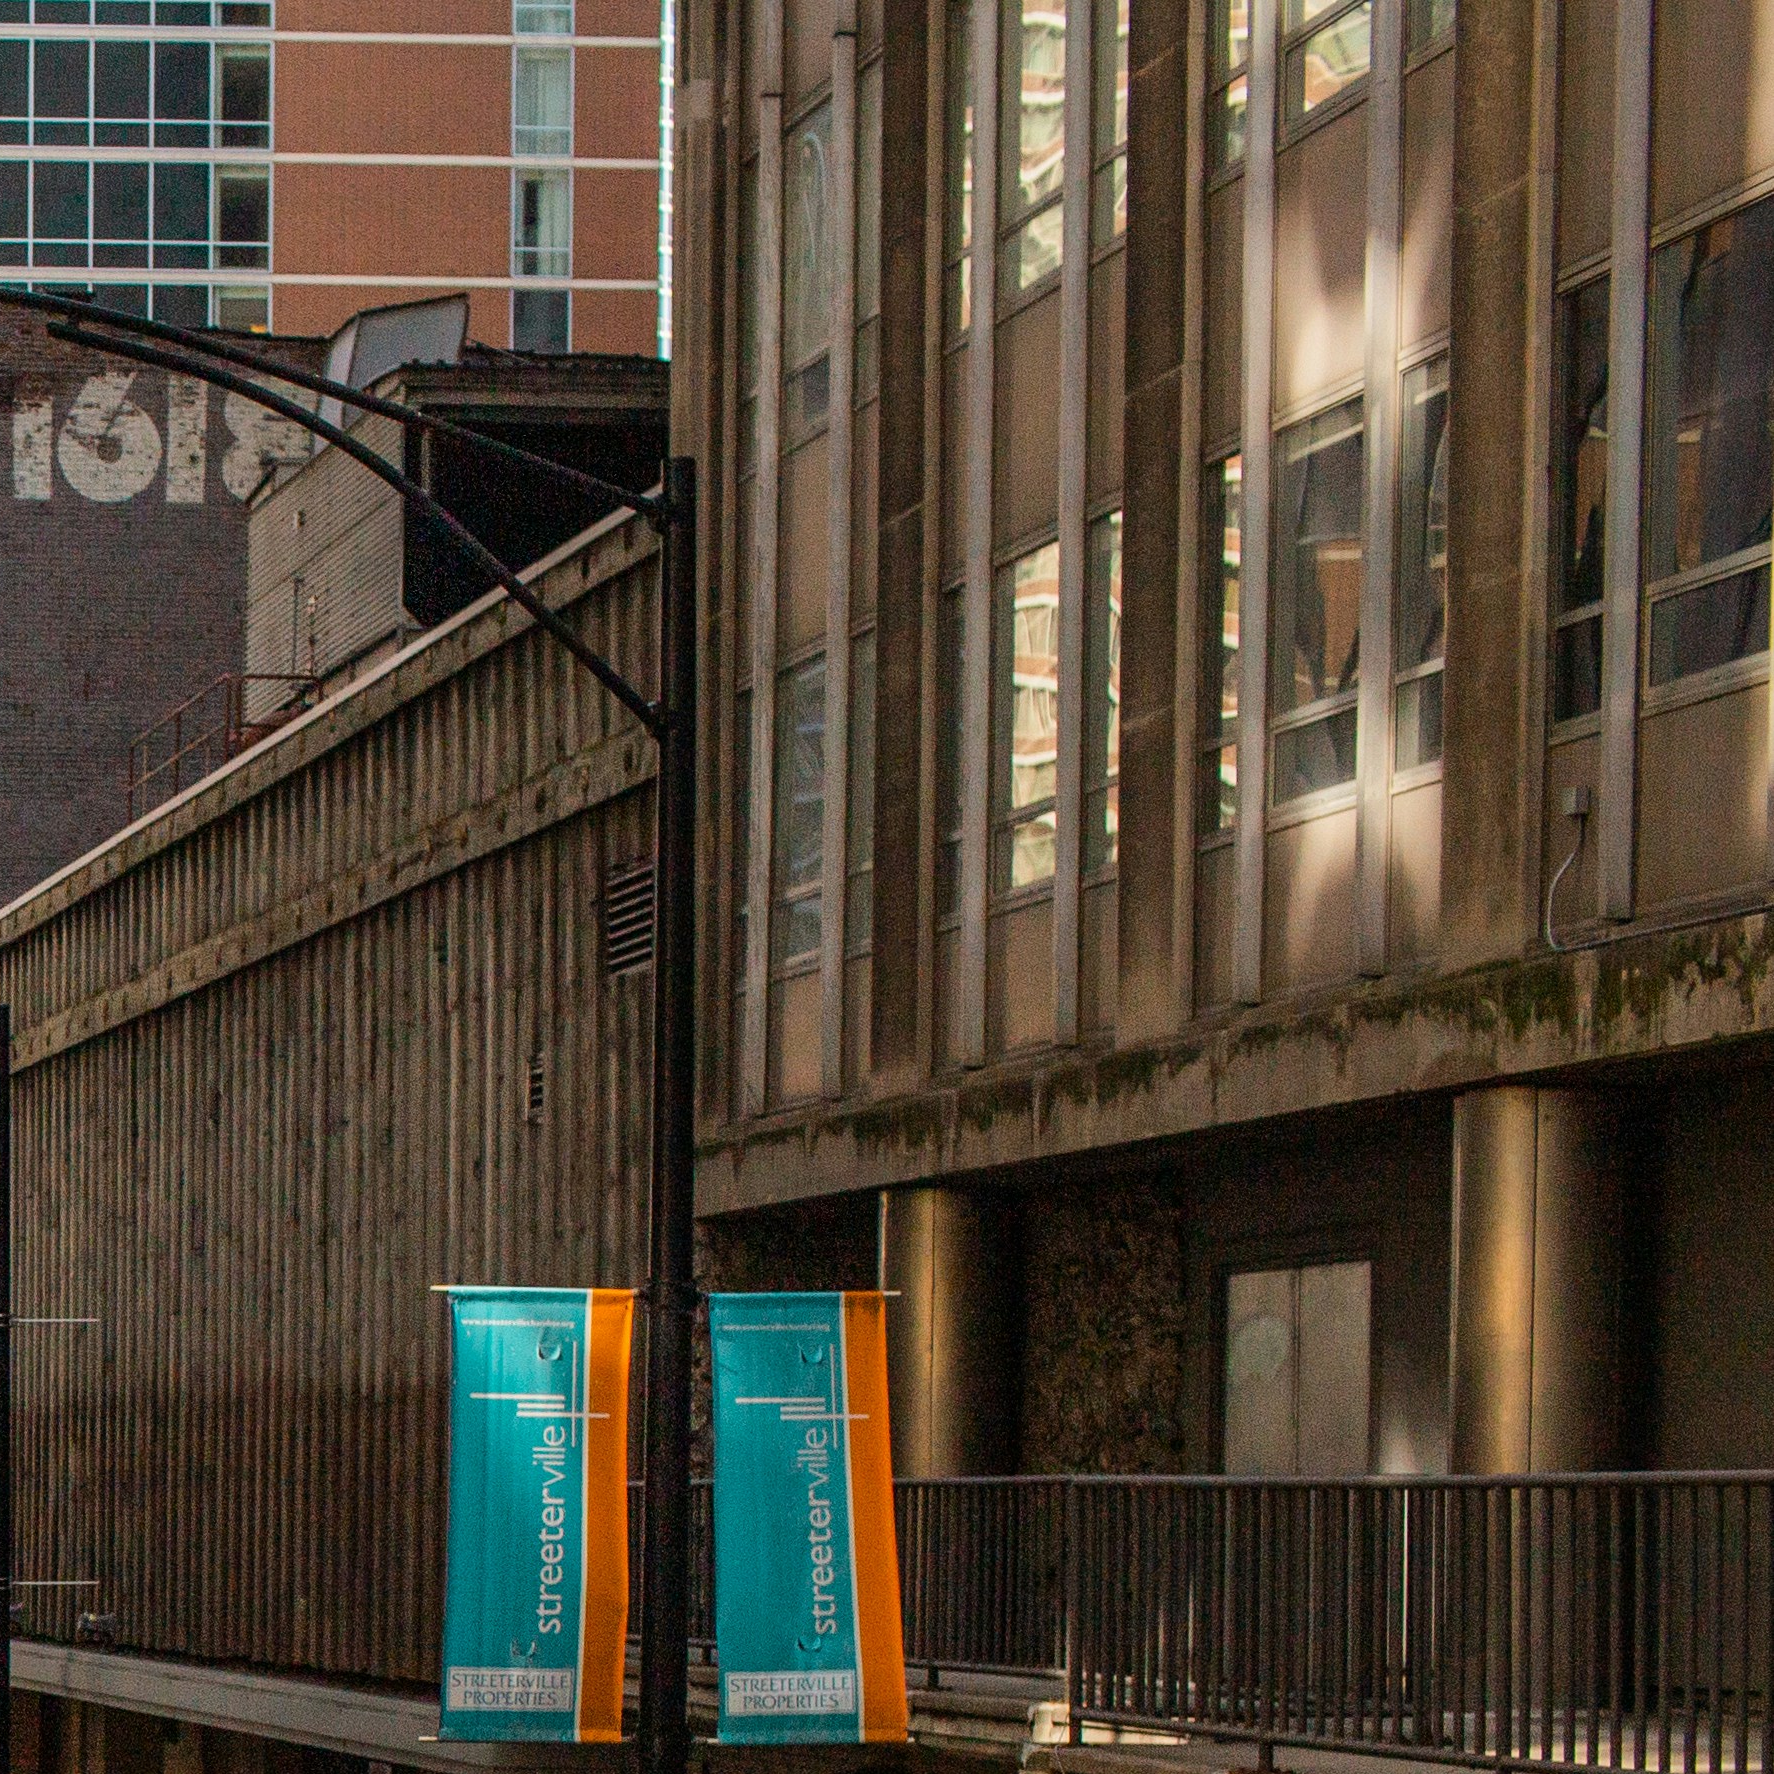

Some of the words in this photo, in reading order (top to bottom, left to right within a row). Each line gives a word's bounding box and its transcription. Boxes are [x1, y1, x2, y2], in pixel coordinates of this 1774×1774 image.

[532, 1425, 567, 1634] streeterville
[797, 1427, 837, 1634] streeterville
[452, 1674, 568, 1689] STREETERVILLE
[731, 1676, 851, 1692] STREETERVILLE
[464, 1691, 556, 1705] PROPERTIES
[743, 1694, 839, 1710] PROPERTIES
